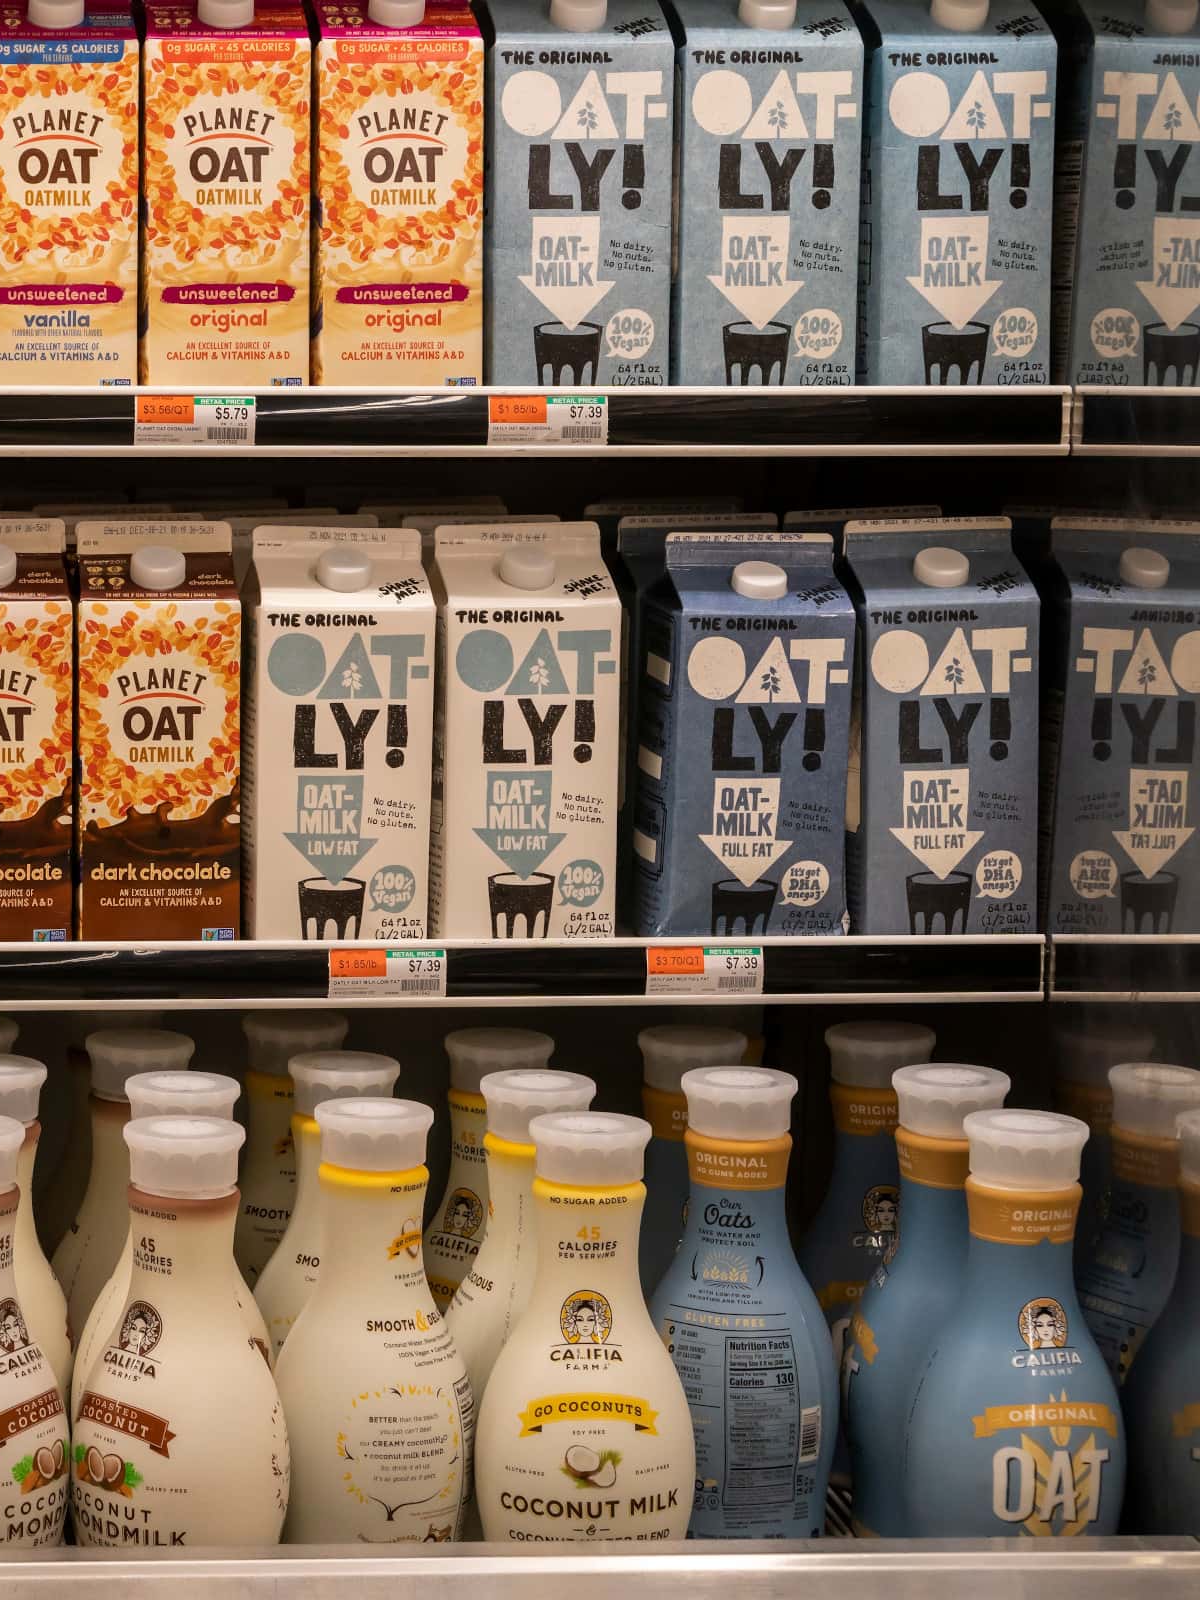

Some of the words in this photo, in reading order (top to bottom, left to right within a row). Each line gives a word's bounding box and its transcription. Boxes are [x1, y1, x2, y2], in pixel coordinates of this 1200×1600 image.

[501, 51, 534, 65] THE
[539, 51, 613, 65] ORIGINAL
[692, 51, 726, 65] THE
[730, 51, 803, 65] ORIGINAL
[888, 53, 922, 66] THE
[927, 52, 998, 65] ORIGINAL
[13, 108, 104, 137] PLANET
[358, 108, 449, 137] PLANET
[18, 148, 98, 184] OAT
[364, 147, 443, 183] OAT
[528, 143, 646, 211] LY!
[719, 143, 834, 211] LY!
[917, 142, 1030, 211] LY!
[371, 189, 437, 205] OATMILK
[539, 235, 589, 261] OAT-
[729, 235, 779, 261] OAT-
[535, 262, 595, 287] MILK
[725, 262, 784, 287] MILK
[8, 288, 107, 302] unsweetened
[179, 286, 278, 300] unsweetened
[353, 287, 453, 301] unsweetened
[24, 311, 90, 328] vanilla
[190, 310, 268, 332] original
[365, 310, 442, 332] original
[612, 316, 650, 336] 100%
[609, 334, 649, 351] Vegan
[216, 407, 248, 421] $5.79
[570, 406, 602, 419] $7.39
[268, 614, 302, 626] THE
[305, 614, 377, 627] ORIGINAL
[689, 617, 723, 630] THE
[727, 618, 798, 630] ORIGINAL
[116, 668, 206, 697] PLANET
[122, 706, 201, 742] OAT
[482, 698, 596, 766] LY!
[899, 698, 1012, 764] LY!
[294, 702, 408, 770] LY!
[711, 706, 826, 773] LY!
[304, 784, 354, 809] OAT-
[300, 809, 358, 834] MILK
[717, 814, 772, 837] MILK
[307, 842, 332, 855] LOW
[334, 841, 359, 855] FAT
[721, 843, 749, 858] FULL
[751, 843, 774, 858] FAT
[91, 863, 136, 881] dark
[139, 863, 231, 881] chocolate
[409, 960, 440, 972] $7.39
[726, 957, 758, 969] $7.39
[697, 1152, 767, 1168] ORIGINAL
[558, 1240, 618, 1252] CALORIES
[550, 1344, 623, 1362] CALIFIA
[730, 1342, 766, 1350] Nutrition
[769, 1341, 789, 1349] Facts
[1011, 1351, 1082, 1368] CALIFIA
[776, 1373, 793, 1384] 130
[535, 1404, 553, 1417] GO
[558, 1402, 642, 1417] COCONUTS
[1008, 1407, 1097, 1421] ORIGINAL
[992, 1446, 1111, 1523] OAT
[501, 1492, 619, 1519] COCONUT
[630, 1489, 678, 1513] MILK
